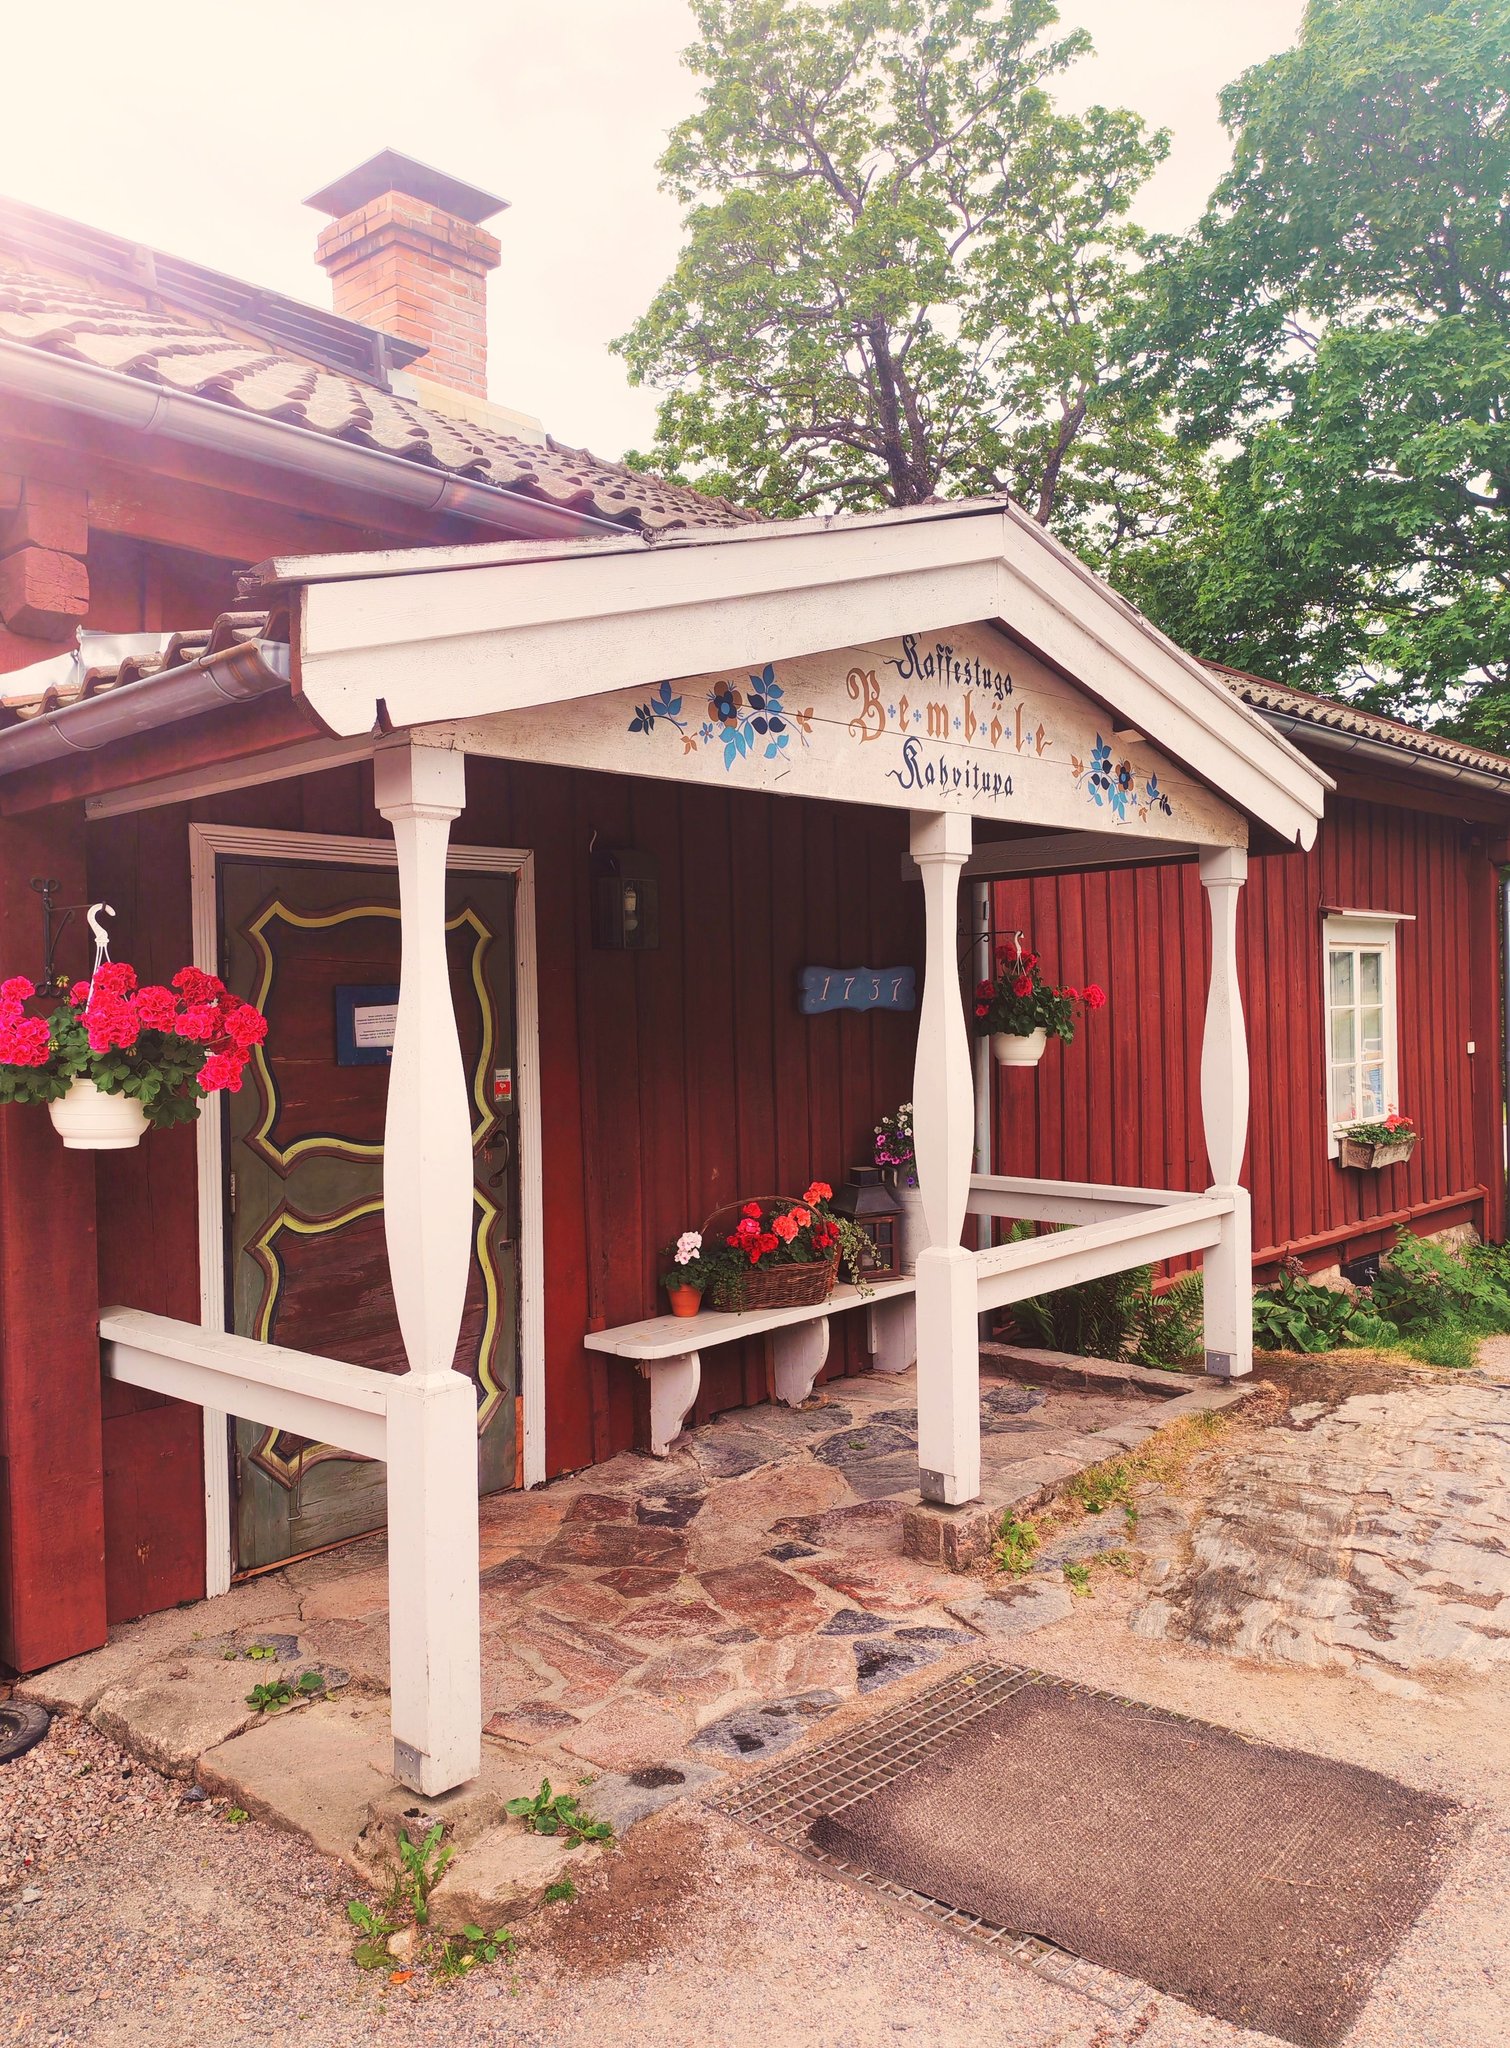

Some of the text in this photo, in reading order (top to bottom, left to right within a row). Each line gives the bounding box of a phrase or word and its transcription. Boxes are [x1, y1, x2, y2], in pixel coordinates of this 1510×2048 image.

[883, 632, 1013, 701] Kaffestuga
[846, 667, 1053, 757] Bemböle
[885, 736, 1014, 803] Kahvitupa
[820, 975, 903, 1002] 1737
